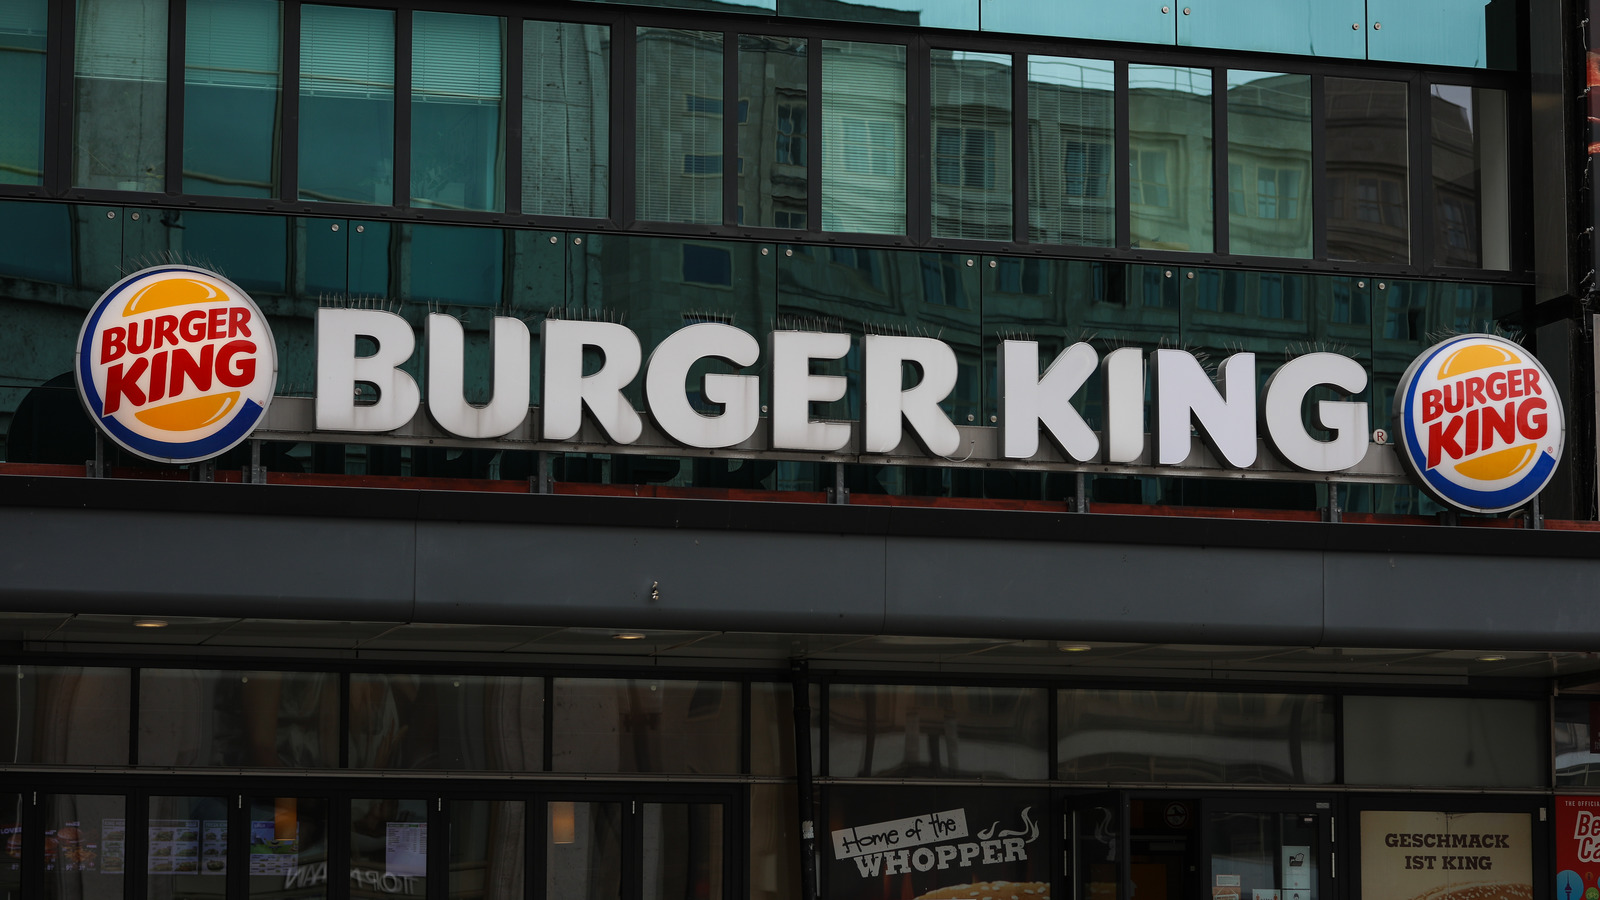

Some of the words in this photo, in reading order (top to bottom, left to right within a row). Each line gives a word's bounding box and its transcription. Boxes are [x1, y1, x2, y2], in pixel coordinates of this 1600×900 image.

[100, 307, 252, 365] BURGER
[104, 340, 257, 416] KING
[314, 306, 961, 459] BURGER
[997, 339, 1370, 473] KING
[1421, 368, 1542, 424] BURGER
[1427, 397, 1548, 469] KING
[842, 827, 899, 853] Home
[905, 818, 922, 841] of
[929, 813, 956, 838] the
[853, 837, 1028, 878] WHOPPER
[1384, 833, 1510, 849] GESCHMACK
[1405, 855, 1437, 870] IST
[1441, 855, 1493, 871] KING
